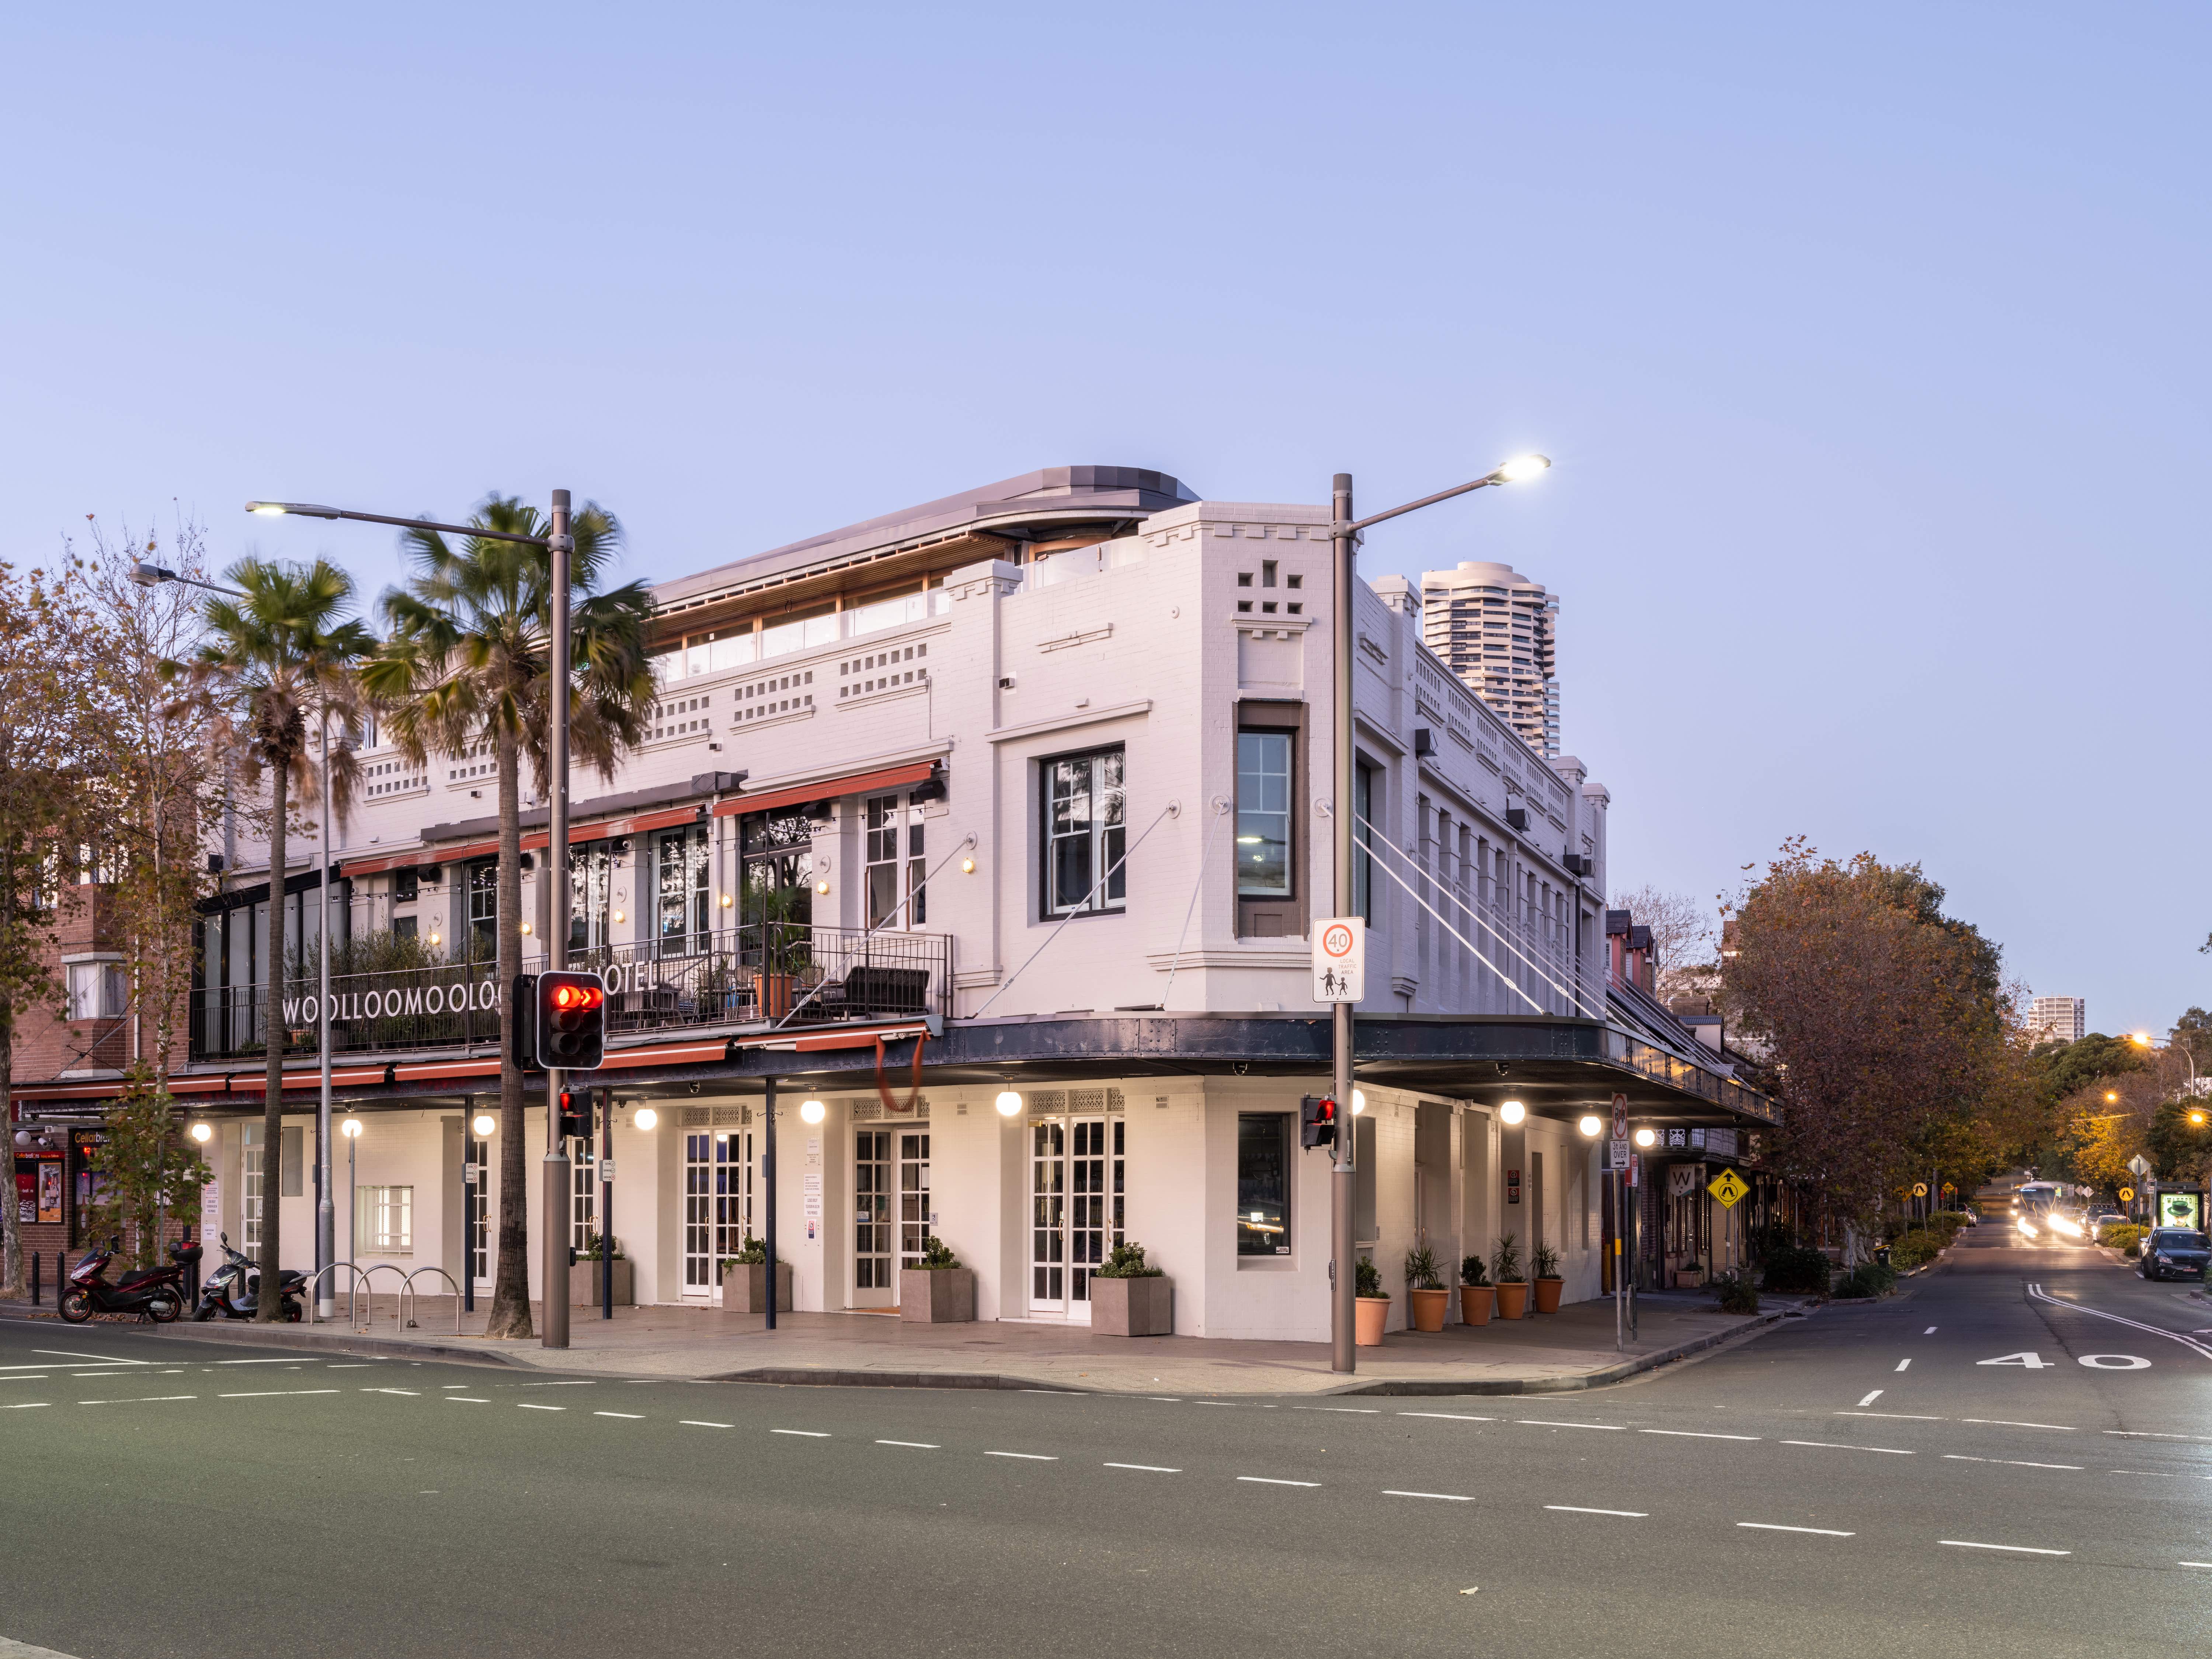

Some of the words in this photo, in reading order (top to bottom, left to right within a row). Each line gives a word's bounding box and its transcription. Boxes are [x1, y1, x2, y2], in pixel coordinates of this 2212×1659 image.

[1328, 933, 1347, 948] 40
[283, 980, 501, 1025] WOOLLOOMOOLO
[588, 960, 658, 995] OTEL
[1613, 1142, 1618, 1150] 3t
[1673, 1172, 1691, 1185] W
[1976, 1352, 2152, 1369] 40
